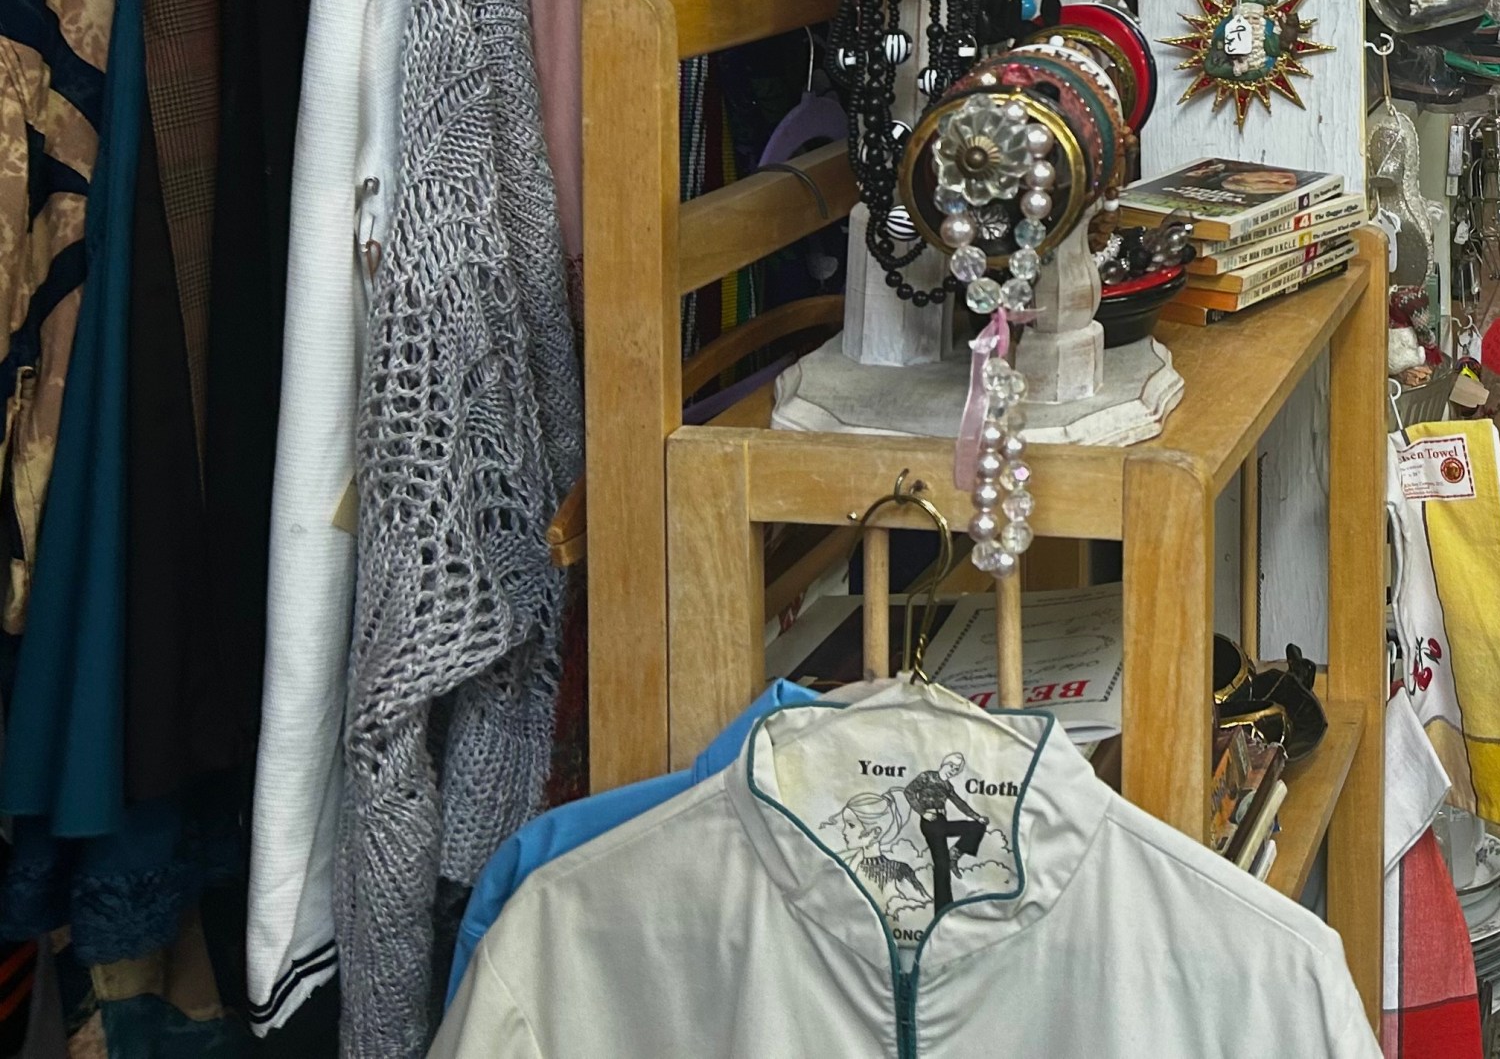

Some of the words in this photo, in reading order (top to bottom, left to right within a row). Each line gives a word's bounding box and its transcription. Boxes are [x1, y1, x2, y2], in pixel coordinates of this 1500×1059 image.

[1299, 214, 1309, 227] 4
[1315, 210, 1324, 220] The
[1238, 253, 1248, 264] THE
[1249, 250, 1260, 260] MAN
[1261, 246, 1274, 258] FROM
[1425, 446, 1458, 459] Towel
[858, 760, 906, 778] Your
[965, 779, 1022, 797] Cloth
